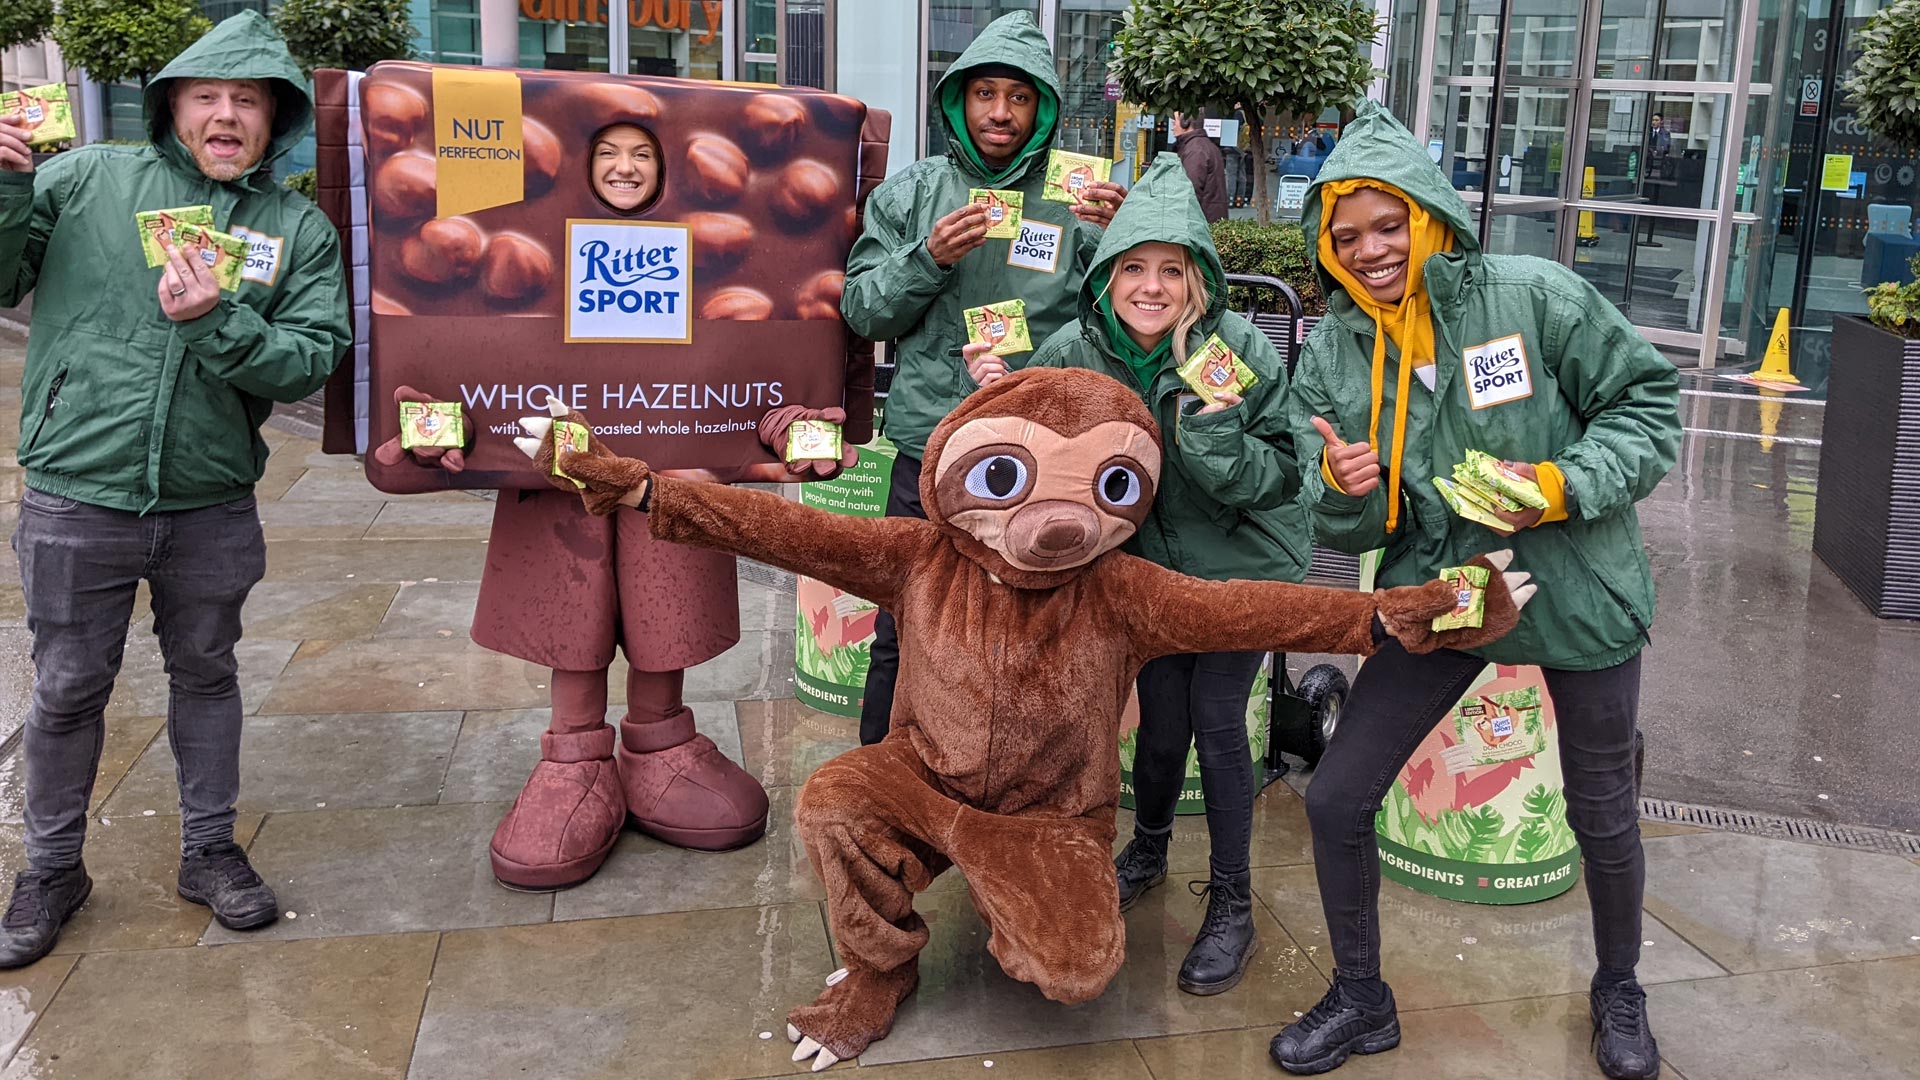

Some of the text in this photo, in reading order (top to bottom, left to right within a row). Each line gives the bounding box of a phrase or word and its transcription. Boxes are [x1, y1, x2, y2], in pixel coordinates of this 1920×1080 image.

[520, 0, 721, 43] ainbury
[453, 118, 504, 140] NUT
[439, 146, 520, 160] PERFECTION
[1017, 227, 1055, 247] Ritter
[1014, 245, 1053, 260] SPORT
[244, 258, 273, 272] ORT
[579, 240, 680, 288] Ritter
[578, 289, 680, 314] SPORT
[1469, 347, 1520, 380] Ritter
[1474, 369, 1523, 394] SPORT
[460, 381, 784, 411] WHOLE HAZELNUTS
[489, 421, 521, 435] with
[590, 420, 642, 436] oasted
[646, 420, 690, 435] whole
[694, 418, 757, 434] hazelnuts
[863, 461, 877, 469] on
[814, 481, 851, 497] harmony
[852, 487, 874, 497] with
[805, 491, 881, 512] people and nature
[797, 677, 849, 705] INGREDIENTS
[1498, 739, 1523, 749] CHOCO
[1178, 789, 1205, 800] GRE
[1377, 847, 1465, 886] NGREDIENTS
[1494, 863, 1571, 889] GREAT TASTE
